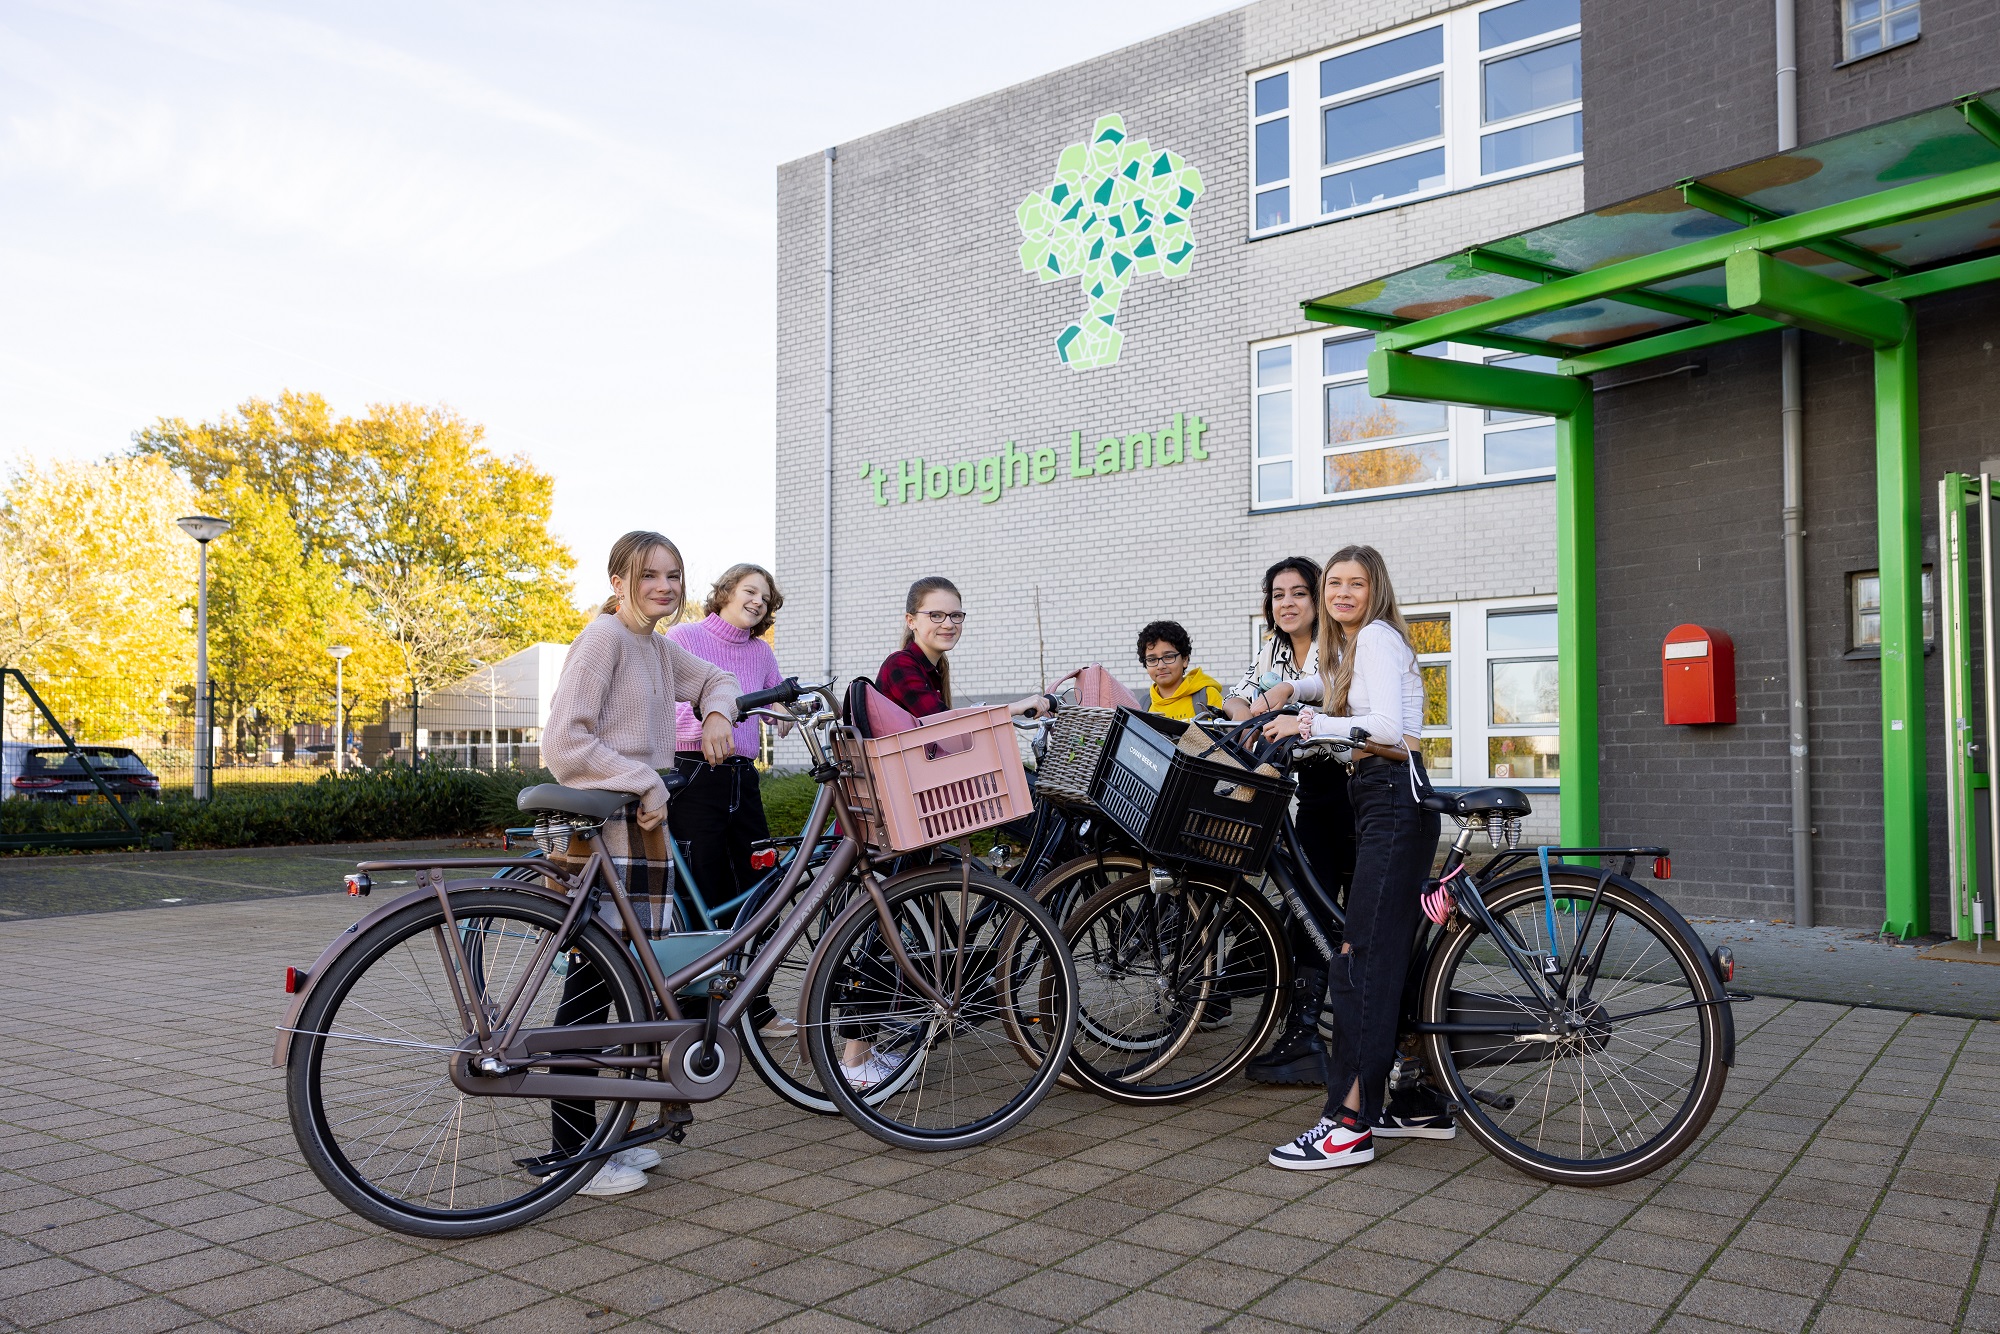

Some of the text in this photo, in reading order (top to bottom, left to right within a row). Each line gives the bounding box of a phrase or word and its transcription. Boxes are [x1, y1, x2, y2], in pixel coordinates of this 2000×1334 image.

[899, 440, 1056, 503] Hooghe
[1071, 412, 1208, 479] Landt
[793, 873, 836, 931] BATAVUS
